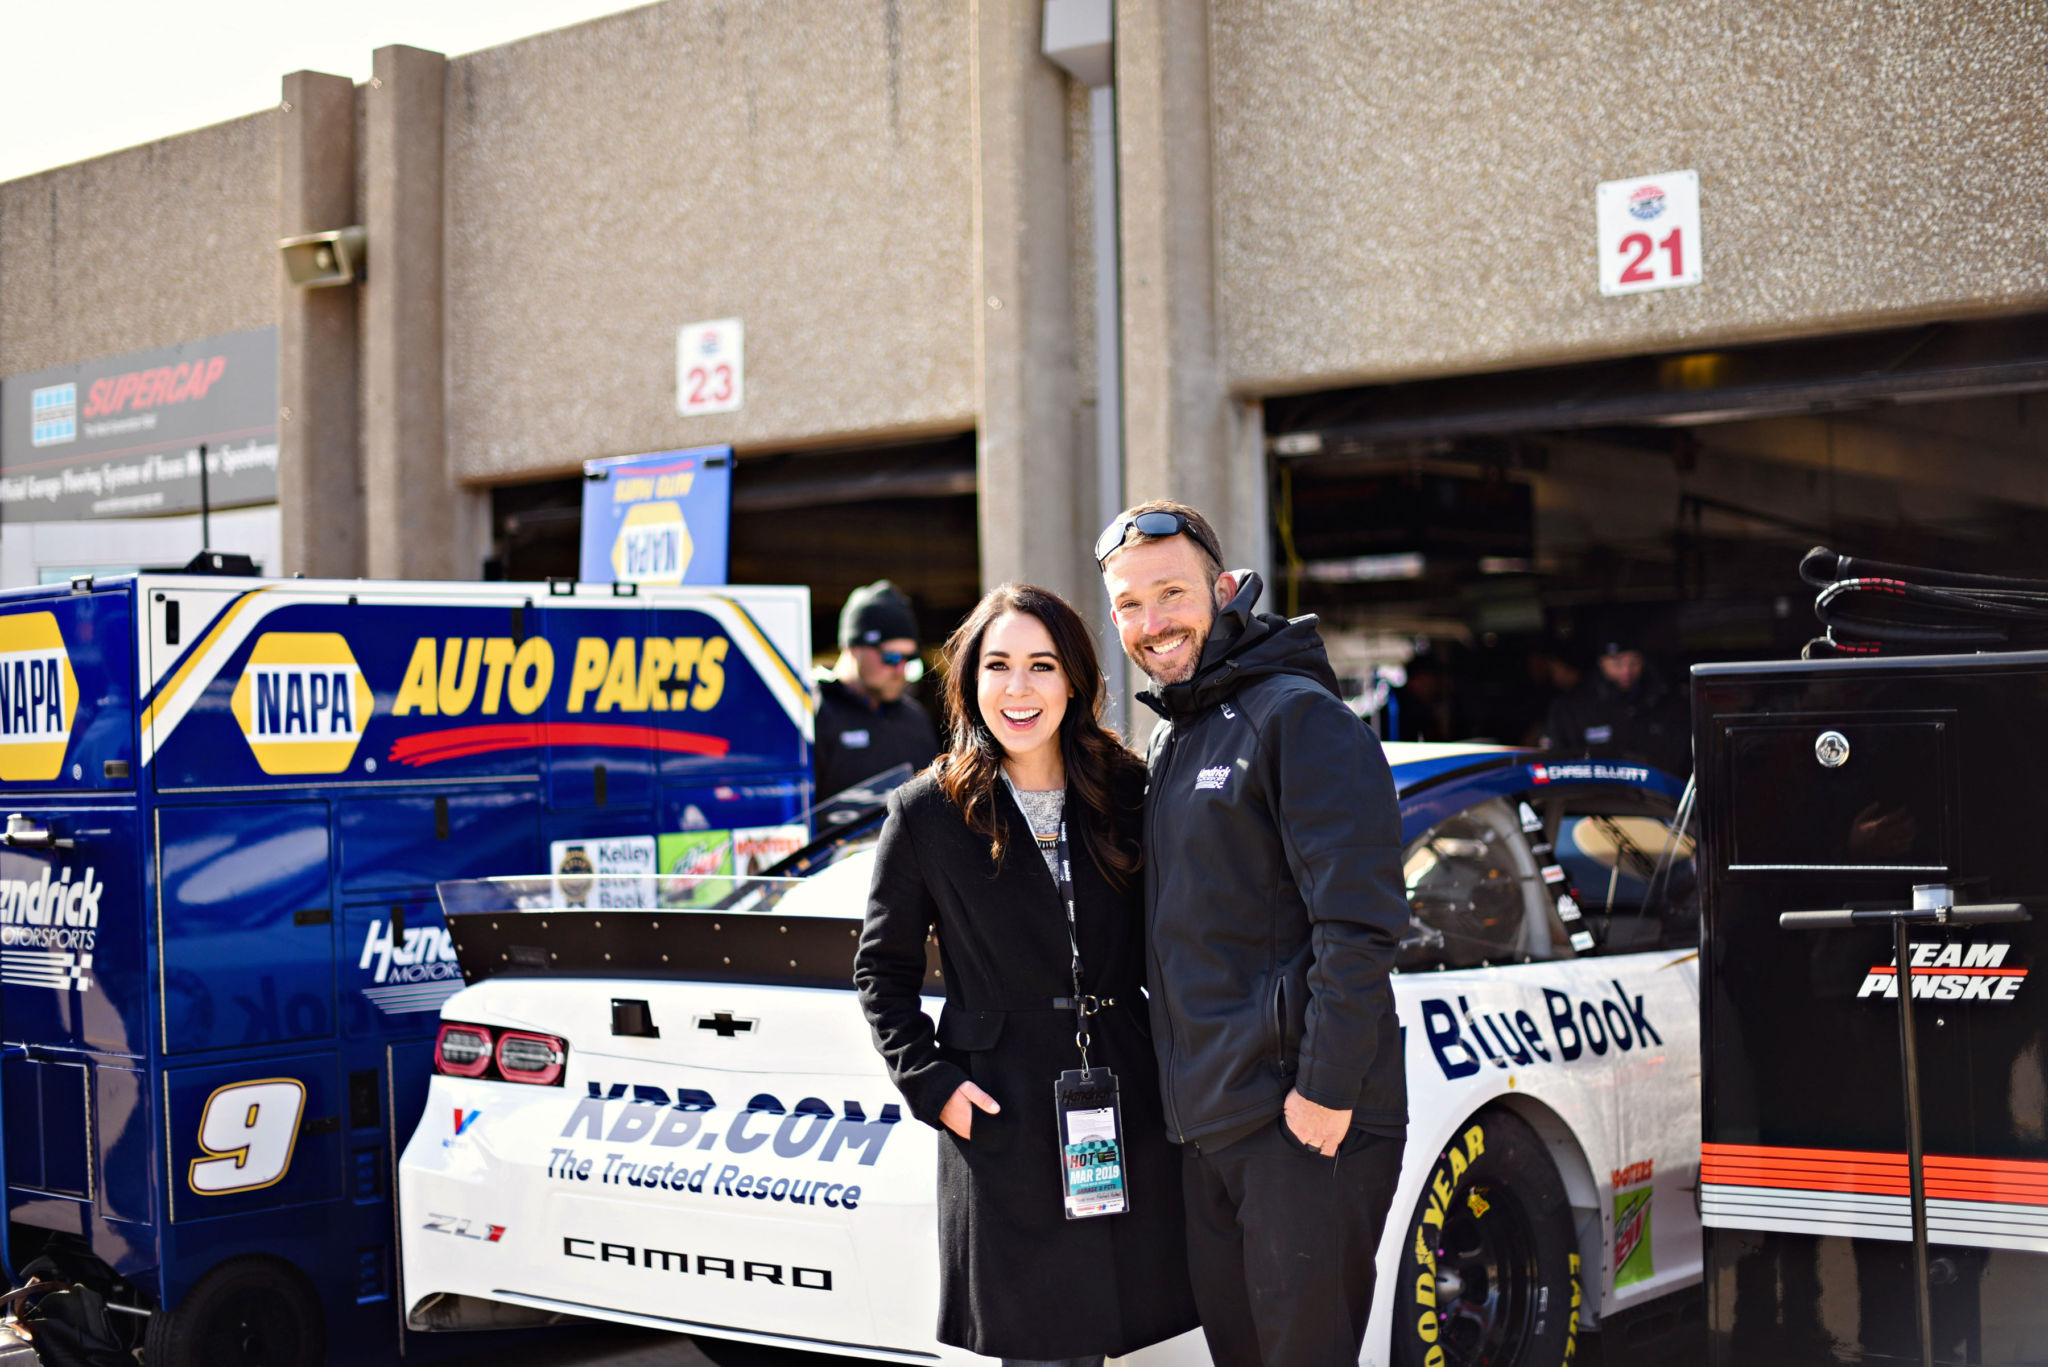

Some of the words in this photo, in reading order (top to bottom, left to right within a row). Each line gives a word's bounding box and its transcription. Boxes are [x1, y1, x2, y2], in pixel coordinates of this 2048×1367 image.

[1619, 228, 1683, 283] 21
[83, 356, 227, 418] SUPERCAP
[689, 365, 735, 404] 23
[257, 672, 353, 735] NAPA
[391, 636, 555, 716] AUTO
[566, 636, 729, 713] PARTS
[600, 843, 650, 866] Kelley
[0, 866, 103, 928] endrick
[1, 926, 97, 951] OTORSPORTS
[1421, 995, 1551, 1081] Blue
[1541, 980, 1663, 1062] Book
[188, 1078, 306, 1196] 9
[560, 1082, 901, 1167] KBB.COM
[547, 1148, 593, 1181] The
[603, 1153, 712, 1193] Trusted
[714, 1164, 862, 1210] Resource
[1070, 1152, 1096, 1169] HOT
[1070, 1169, 1094, 1184] MAR
[1095, 1164, 1120, 1182] 2019
[563, 1236, 833, 1292] CAMARO
[1414, 1125, 1485, 1367] OODYEAR
